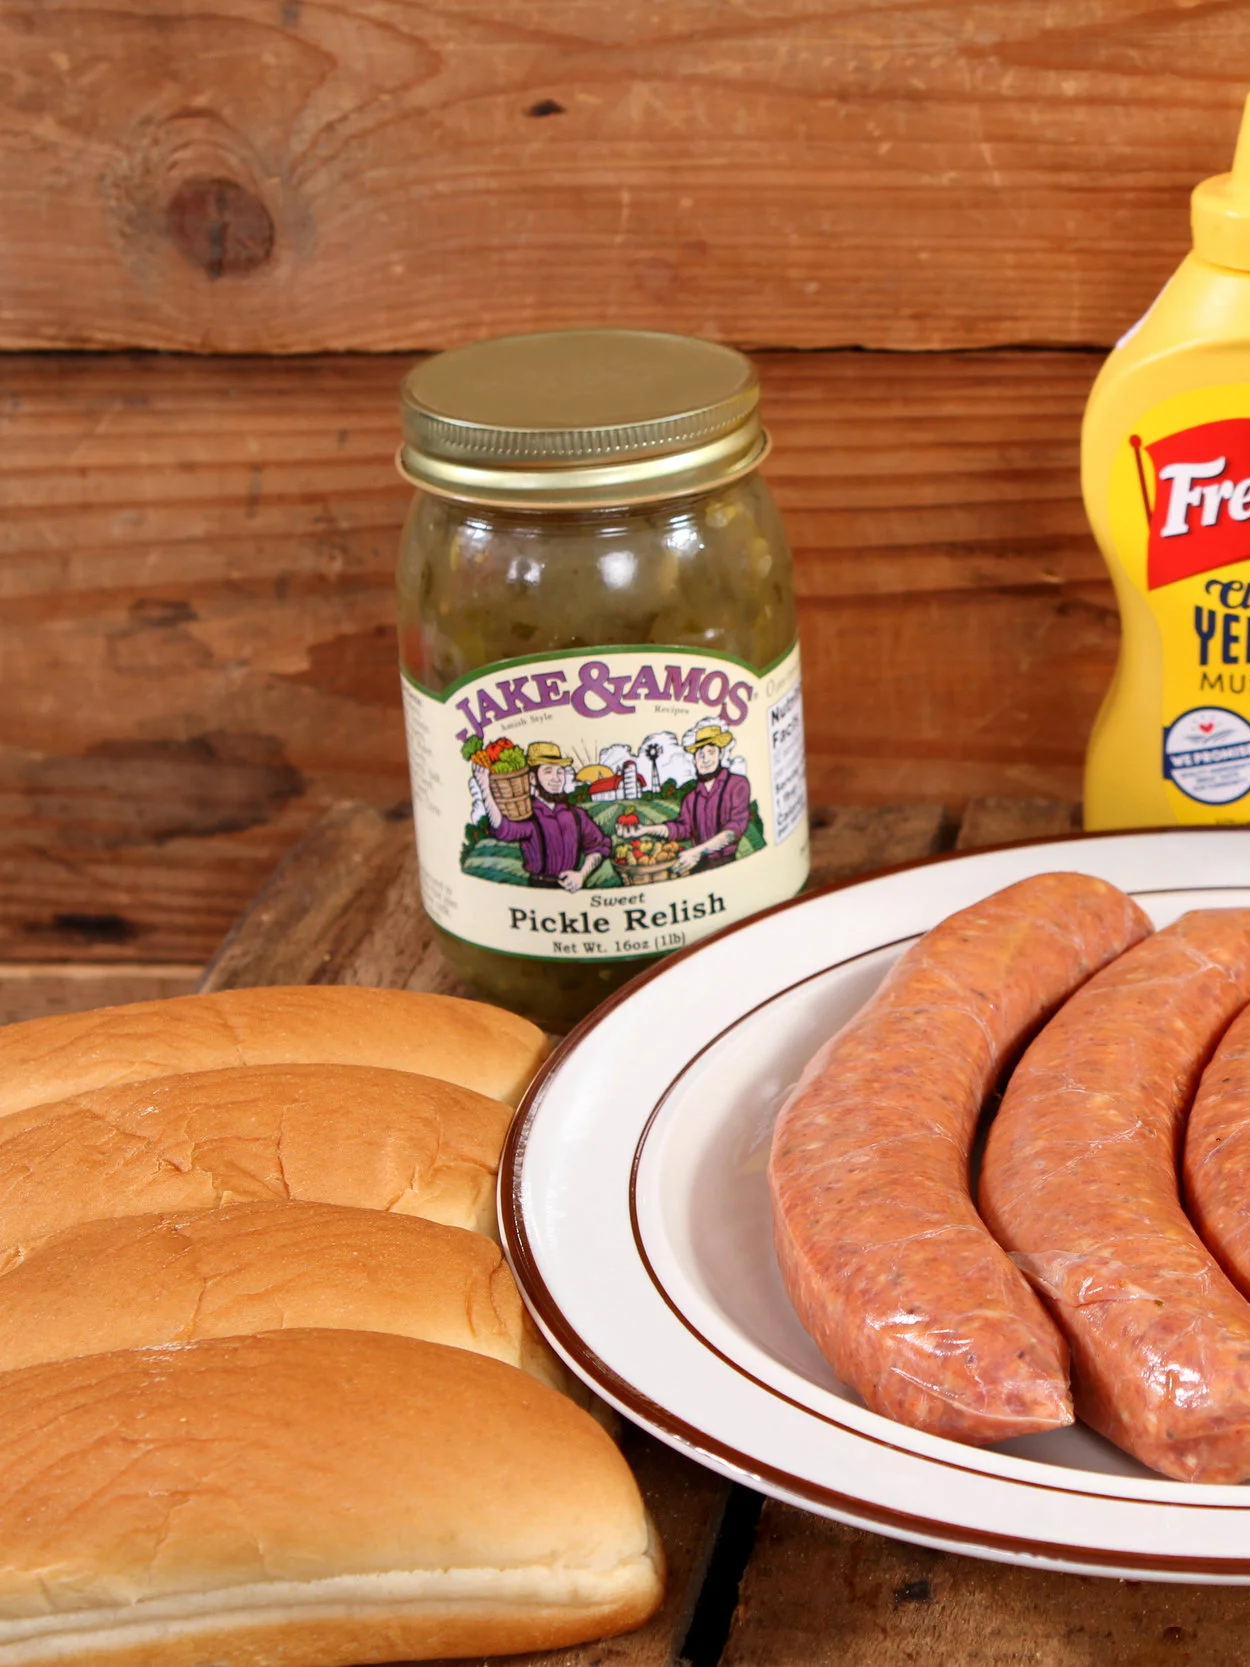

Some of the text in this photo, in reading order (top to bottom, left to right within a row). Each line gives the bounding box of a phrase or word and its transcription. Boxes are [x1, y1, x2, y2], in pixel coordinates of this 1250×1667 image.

[654, 705, 690, 716] Recipes
[530, 712, 553, 725] Style
[590, 893, 646, 908] Sweet
[508, 892, 727, 934] Pickle Relish
[552, 931, 686, 954] Net Wt. 16oz (1lb)
